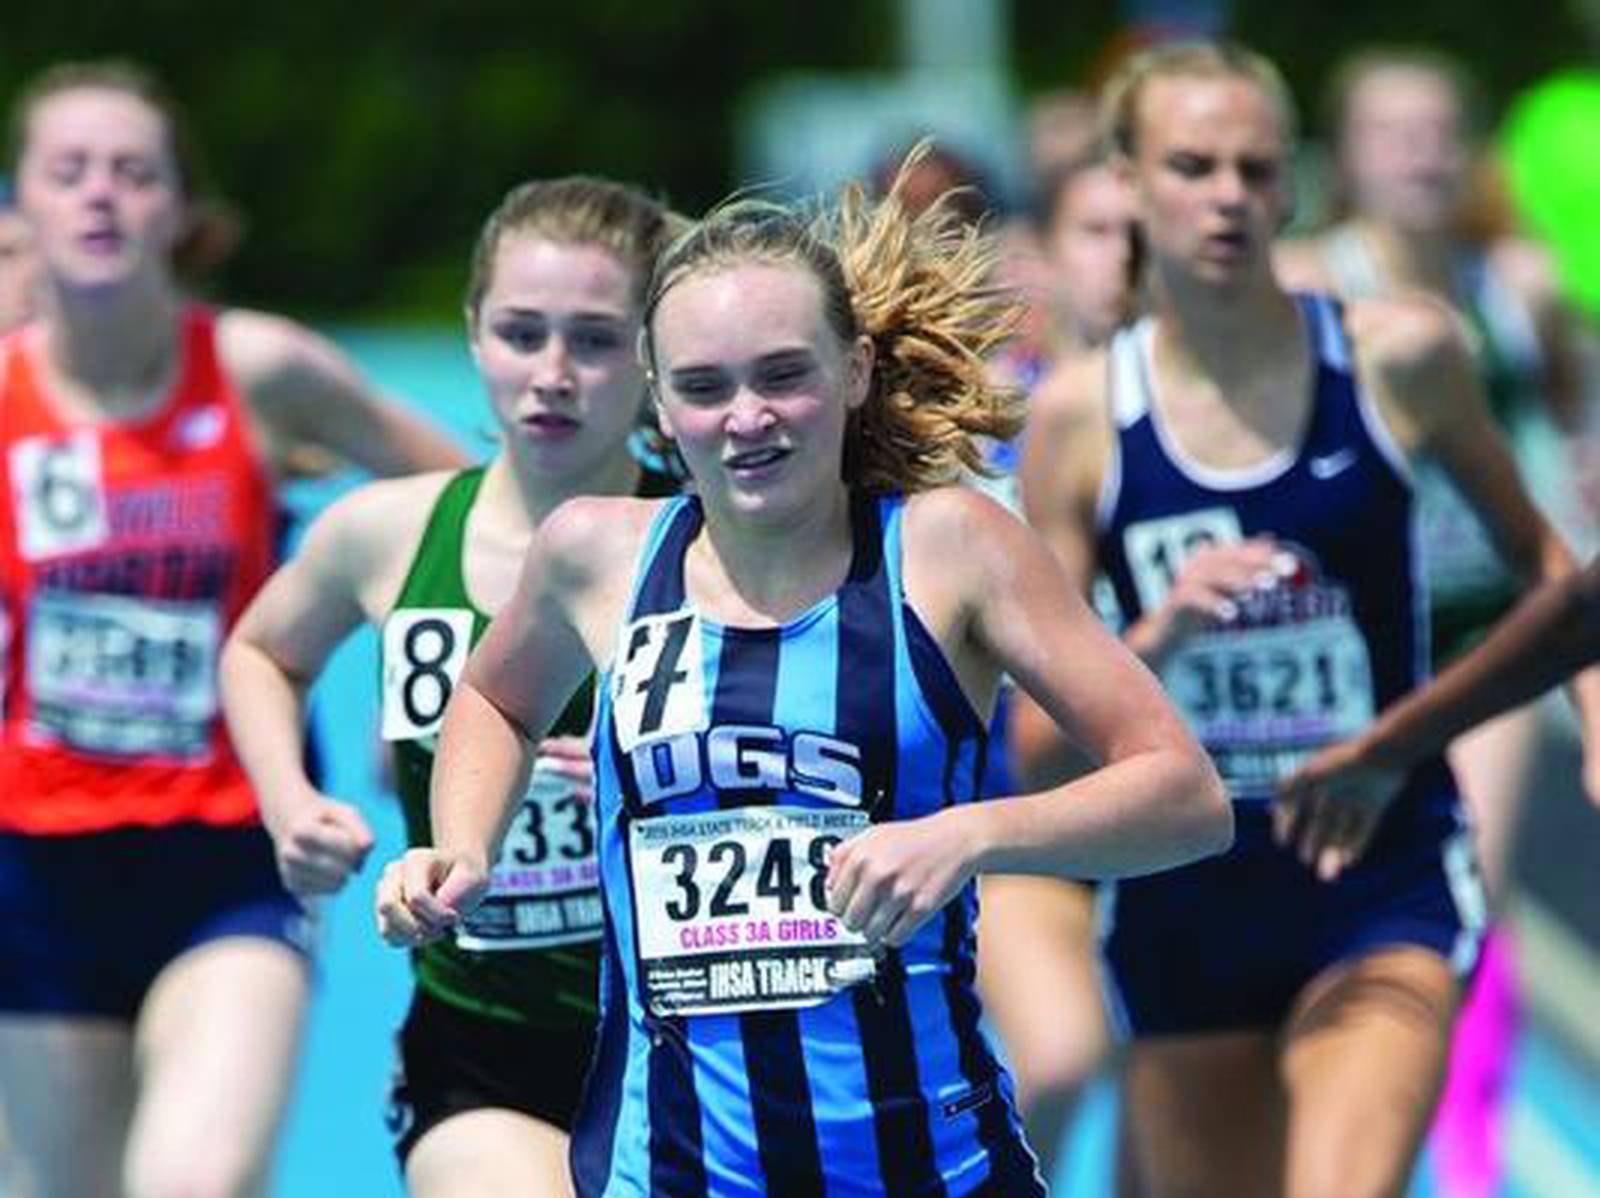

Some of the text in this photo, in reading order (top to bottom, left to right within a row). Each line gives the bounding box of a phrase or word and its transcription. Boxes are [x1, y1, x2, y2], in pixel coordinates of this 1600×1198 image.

[37, 446, 87, 530] 6
[404, 618, 454, 727] 8
[627, 614, 695, 736] 7
[1189, 652, 1337, 719] 3621
[632, 726, 863, 807] DGS
[681, 918, 838, 949] CLASS 3A GIRLS
[709, 962, 757, 999] IHSA
[757, 957, 828, 996] TRACK
